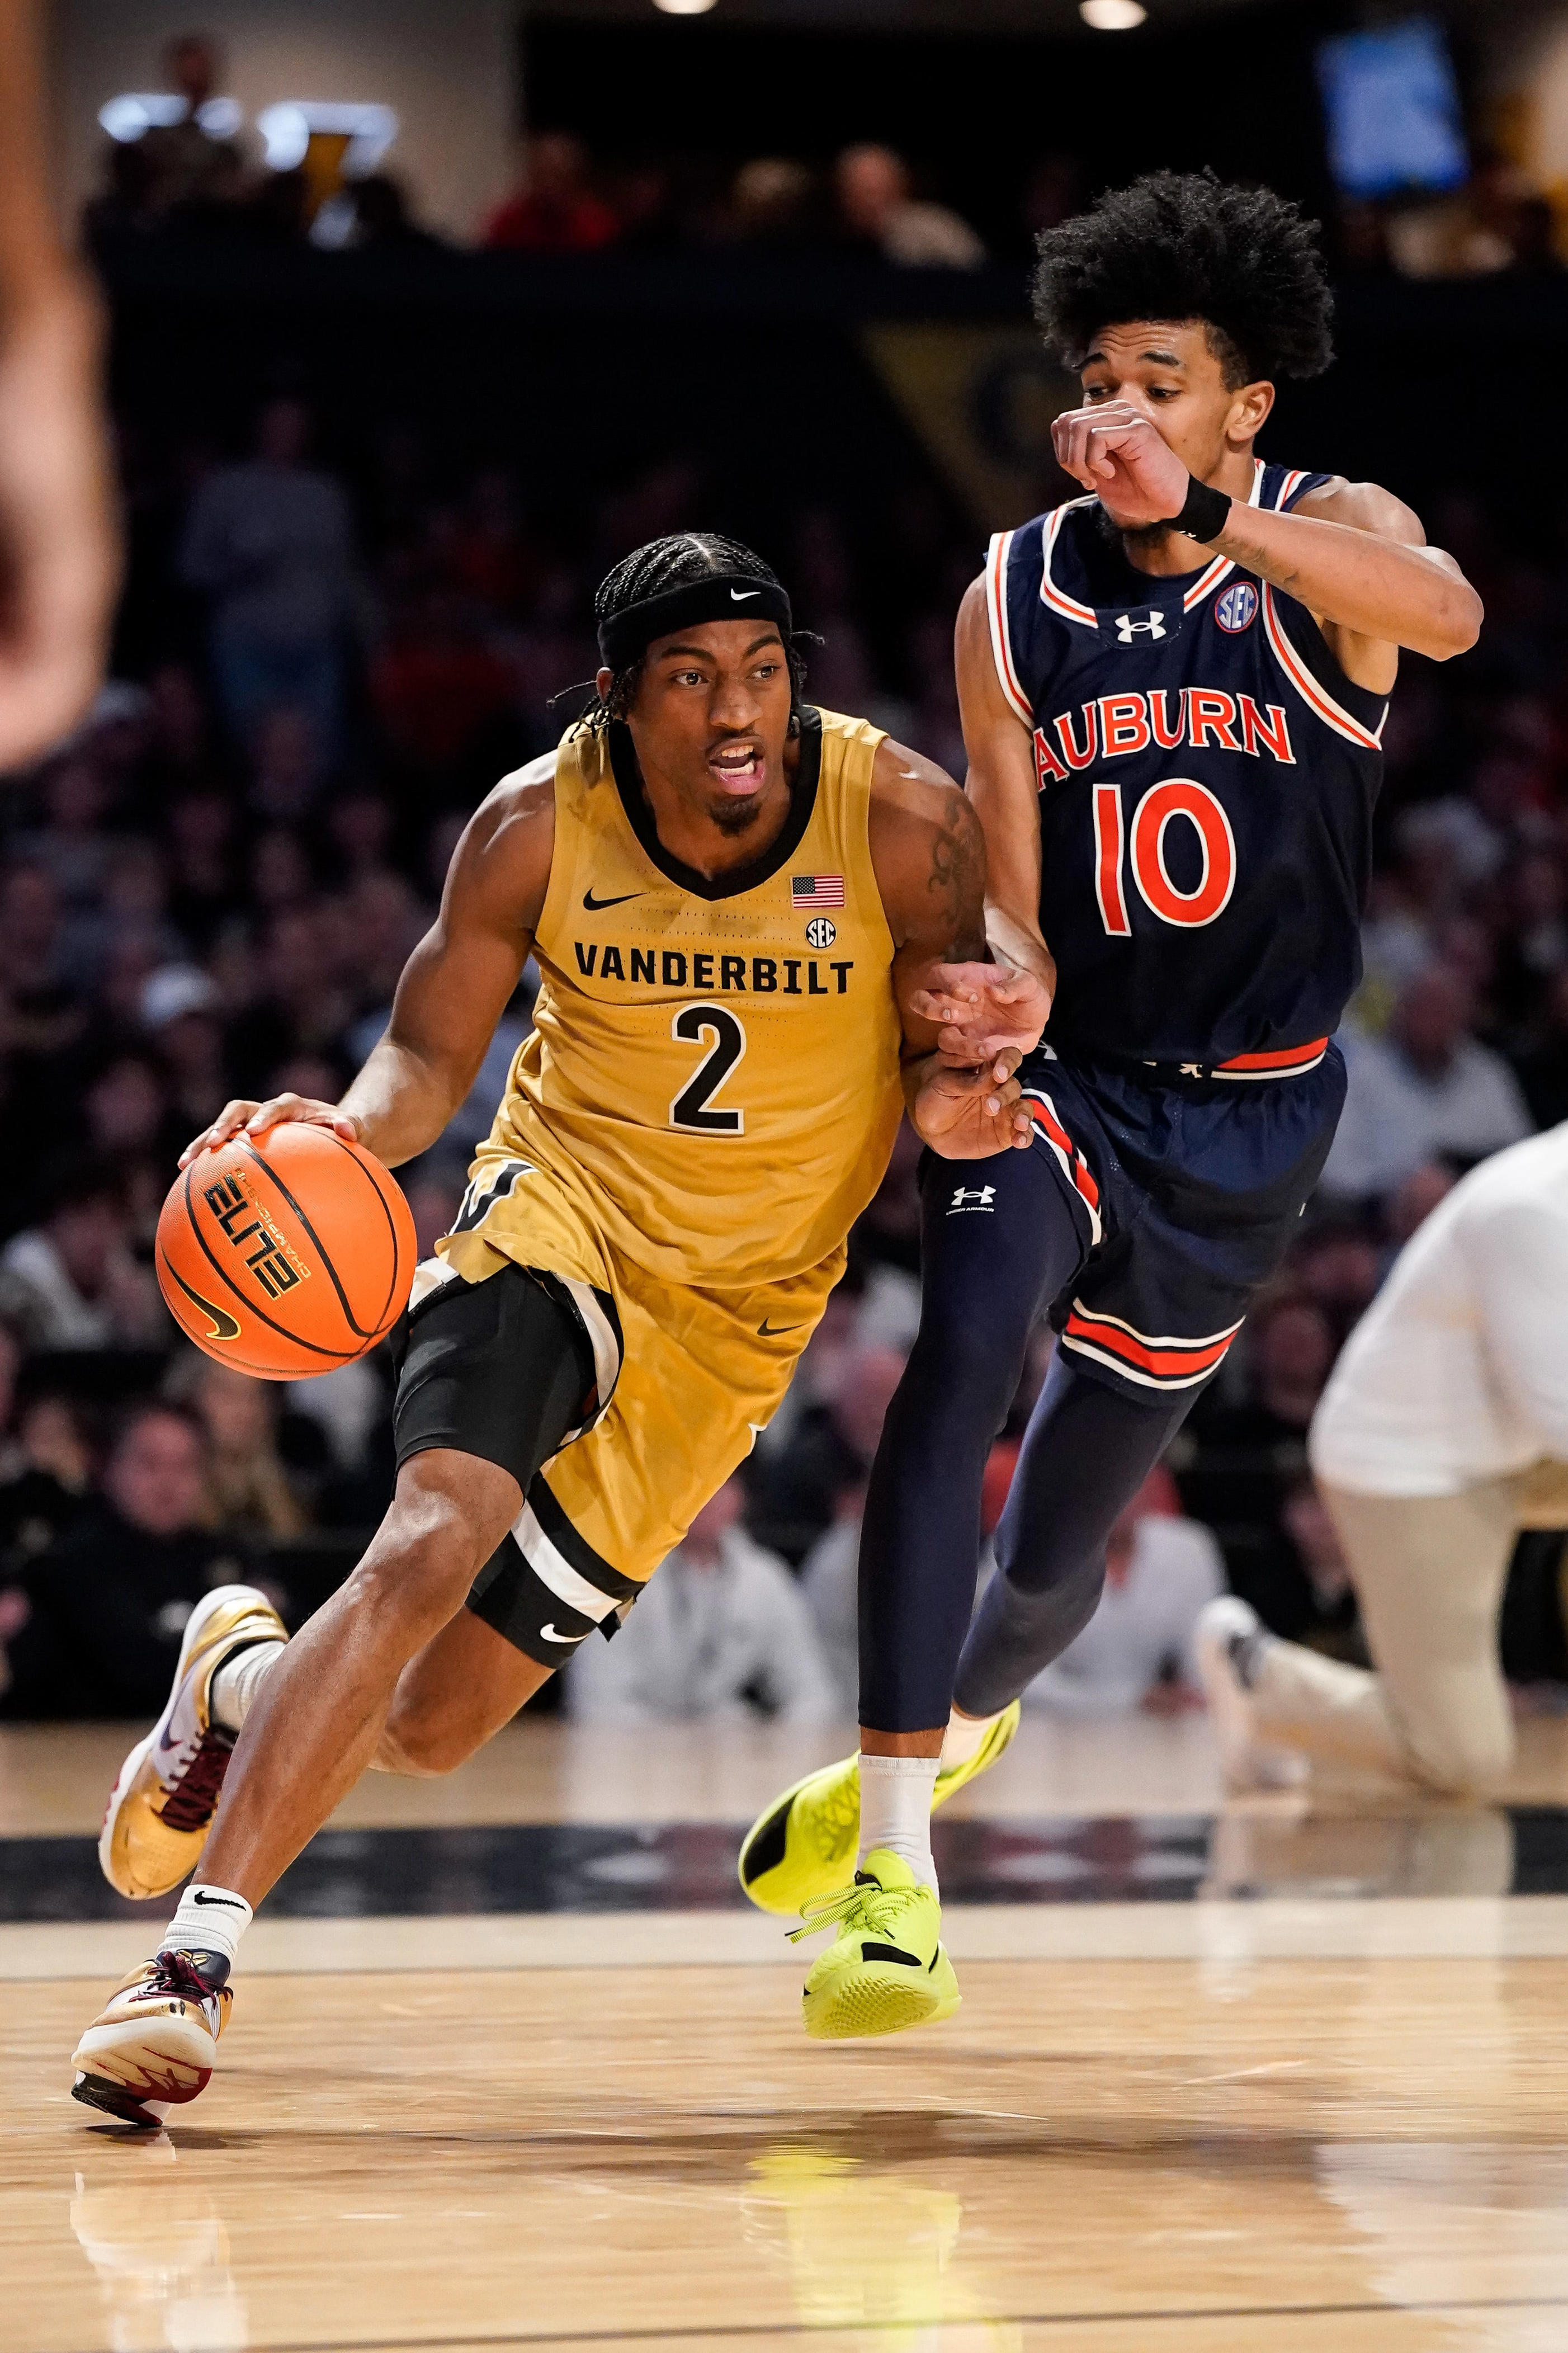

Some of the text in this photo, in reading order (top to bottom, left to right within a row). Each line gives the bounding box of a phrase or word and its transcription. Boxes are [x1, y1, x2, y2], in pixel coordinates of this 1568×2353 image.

[1218, 585, 1255, 630] SEC
[1033, 686, 1297, 792] AUBURN
[1092, 777, 1237, 937] 10
[573, 941, 854, 994] VANDERBILT
[807, 919, 835, 947] SEC
[669, 1002, 747, 1136] 2
[204, 1172, 303, 1301] ELITE
